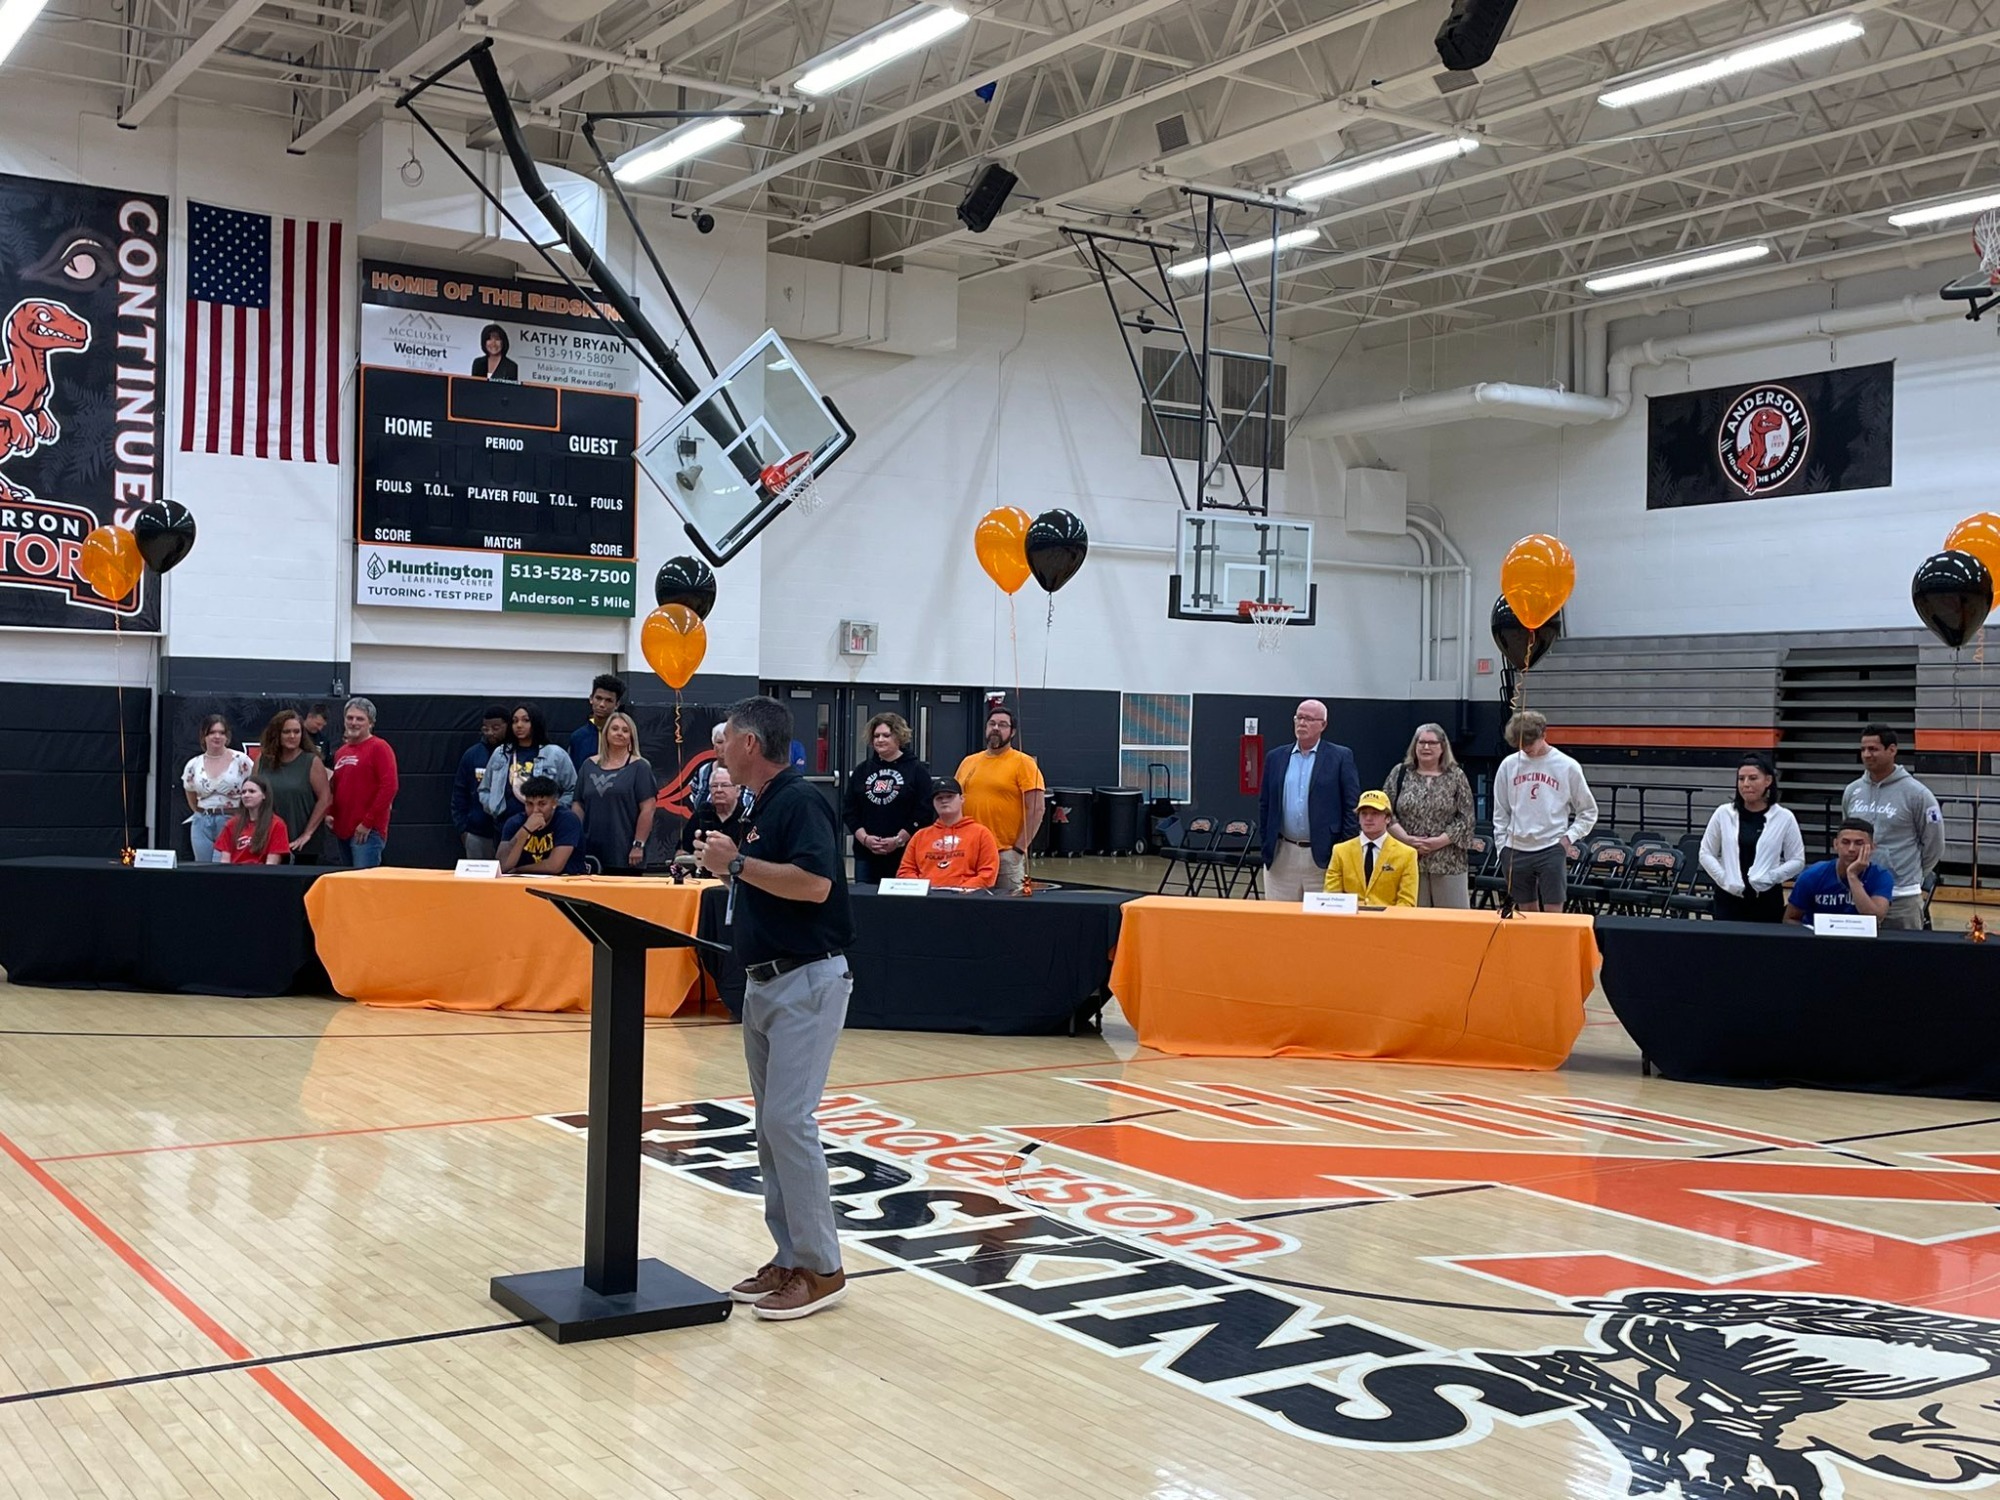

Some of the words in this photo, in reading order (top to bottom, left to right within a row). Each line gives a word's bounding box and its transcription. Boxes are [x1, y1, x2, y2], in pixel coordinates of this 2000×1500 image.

[371, 271, 438, 297] HOME
[443, 281, 473, 301] OF
[479, 286, 523, 309] THE
[528, 292, 625, 323] REDSKIN
[520, 330, 568, 347] KATHY
[573, 337, 629, 354] BRYANT
[534, 345, 615, 365] 513-919-5809
[537, 363, 566, 376] Making
[568, 366, 585, 376] Real
[587, 368, 612, 379] Estate
[532, 372, 550, 382] Easy
[553, 374, 568, 383] and
[571, 377, 617, 390] Rewarding!
[1727, 391, 1802, 434] ANDERSON
[384, 417, 433, 438] HOME
[485, 436, 524, 451] PERIOD
[568, 435, 618, 456] GUEST
[1727, 452, 1741, 476] HOME
[1770, 445, 1800, 480] RAPTORS
[376, 479, 412, 494] FOULS
[424, 483, 454, 497] T.O.L.
[467, 487, 508, 502] PLAYER
[512, 490, 539, 504] FOUL
[549, 493, 577, 507] T.O.L.
[590, 497, 623, 511] FOULS
[1, 509, 79, 537] RSON
[375, 528, 411, 542] SCORE
[484, 535, 521, 550] MATCH
[590, 543, 623, 556] SCORE
[387, 559, 493, 580] Huntington
[510, 564, 630, 584] 513-528-7500
[402, 575, 449, 585] LEARNING
[460, 579, 493, 587] CENTER
[368, 586, 426, 598] TUTORING
[434, 589, 461, 600] TEST
[464, 592, 493, 601] PREP
[509, 591, 574, 605] Anderson
[591, 595, 599, 607] 5
[603, 596, 630, 608] Mile
[1513, 772, 1560, 791] CINCINNATI
[1850, 800, 1897, 818] Kentucky
[1815, 893, 1856, 905] KENTU
